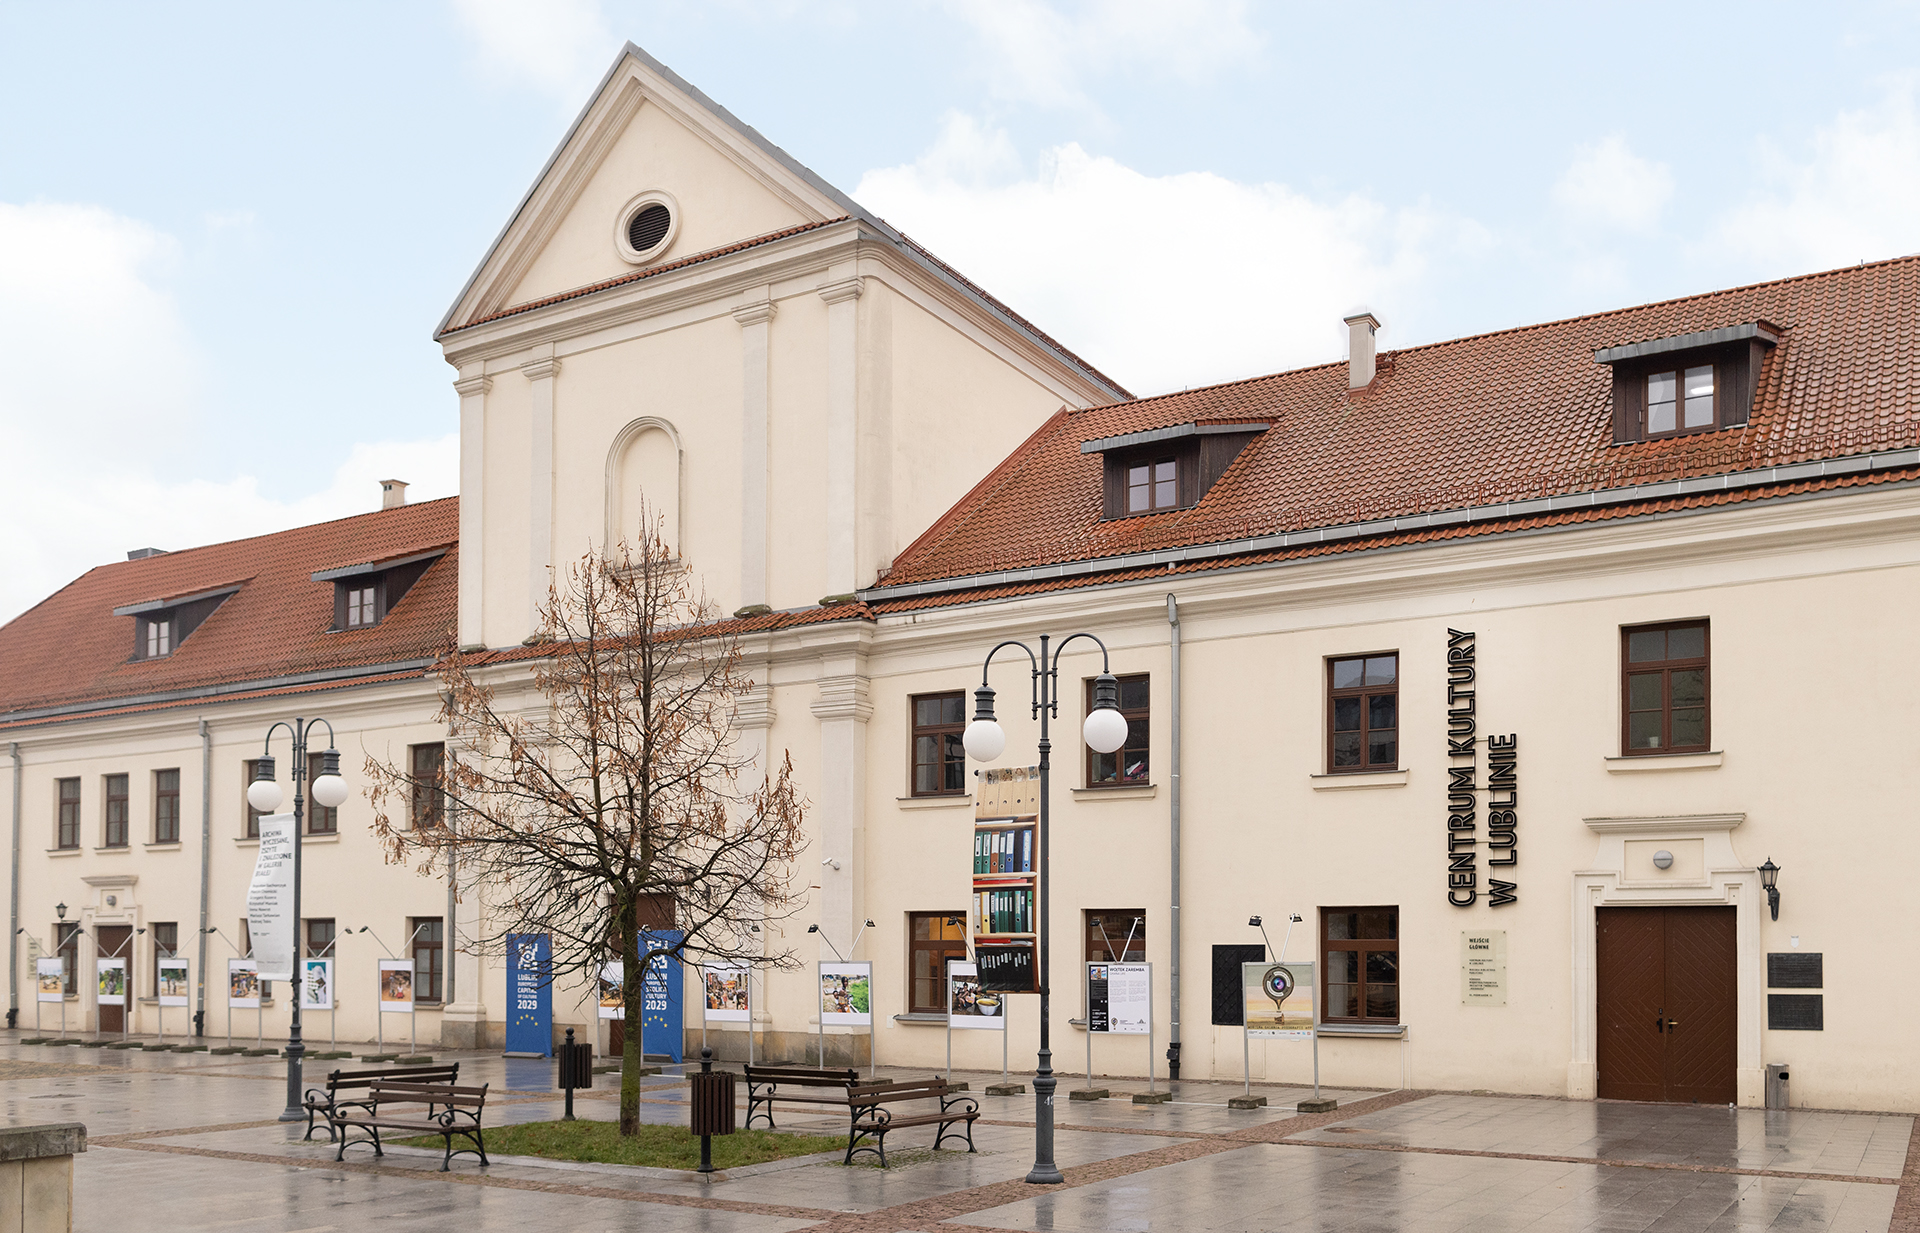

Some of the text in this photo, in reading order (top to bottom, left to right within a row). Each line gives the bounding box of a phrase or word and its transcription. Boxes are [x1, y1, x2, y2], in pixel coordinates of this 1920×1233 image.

[1447, 627, 1476, 907] CENTRUM KULTURY
[1488, 733, 1517, 907] W LUBLINIE
[517, 1000, 537, 1010] 2029
[646, 1000, 667, 1010] 2029
